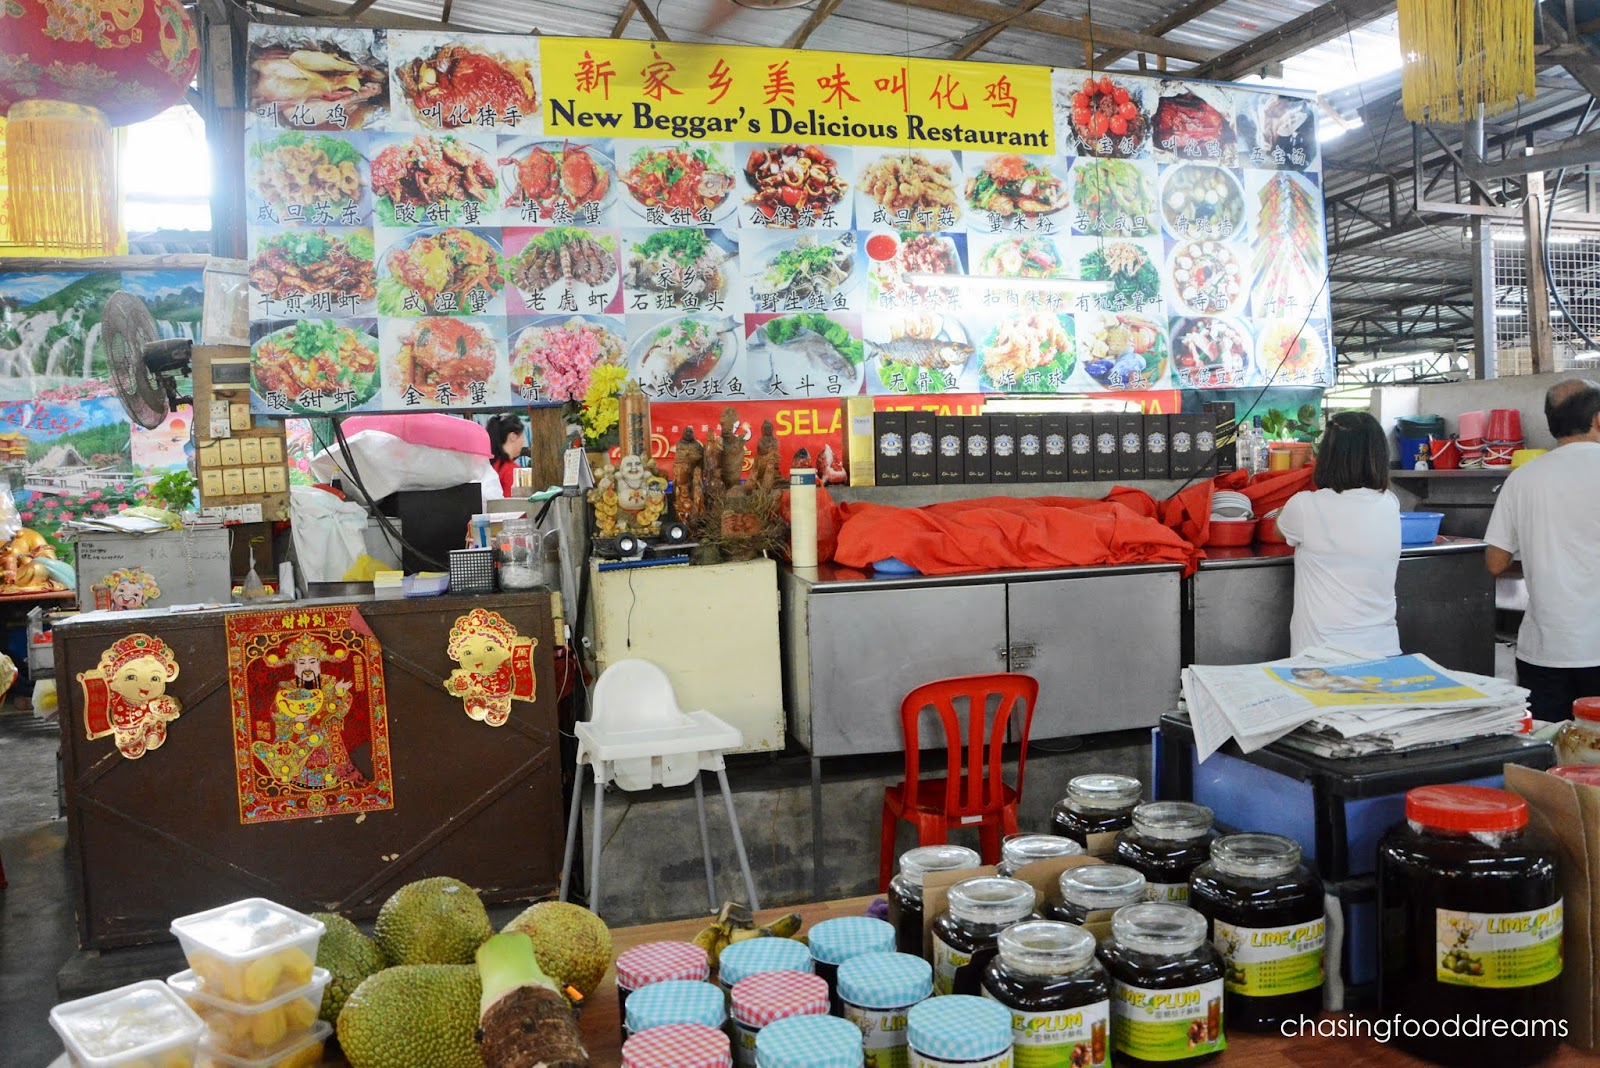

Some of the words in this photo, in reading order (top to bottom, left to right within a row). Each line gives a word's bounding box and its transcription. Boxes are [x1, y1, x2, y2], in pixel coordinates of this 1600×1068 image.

[574, 50, 1018, 118] 新家乡美味叫化鸡
[257, 102, 349, 128] 叫化鸡
[421, 104, 523, 128] 叫化猪手
[549, 98, 623, 128] New
[632, 101, 761, 138] Beggar's
[770, 107, 898, 139] Delicious
[906, 113, 1049, 147] Restaurant
[395, 201, 481, 226] 酸甜蟹
[520, 201, 602, 225] 清蒸蟹
[646, 206, 716, 227] 酸甜鱼
[655, 264, 697, 289] 家乡
[257, 292, 362, 316] 干煎明虾
[525, 289, 609, 313] 老虎虾
[267, 388, 358, 411] 酸甜虾
[401, 381, 488, 406] 金香蟹
[1487, 917, 1531, 935] LIME
[1251, 930, 1290, 948] LIME
[1154, 988, 1200, 1010] PLUM
[1033, 1012, 1083, 1033] PLUM
